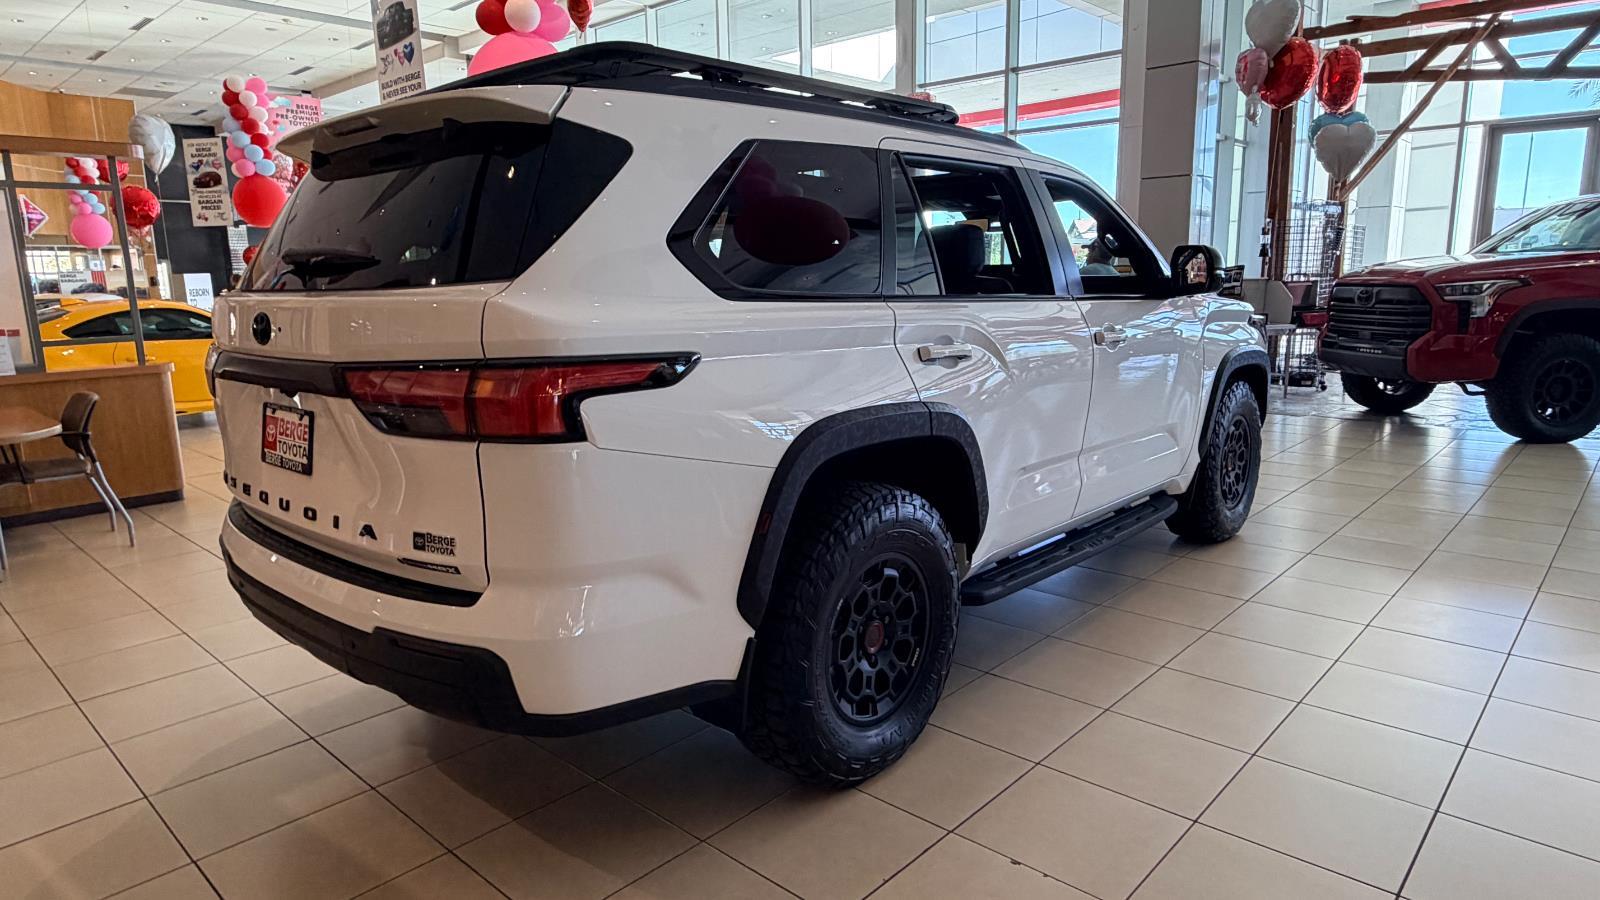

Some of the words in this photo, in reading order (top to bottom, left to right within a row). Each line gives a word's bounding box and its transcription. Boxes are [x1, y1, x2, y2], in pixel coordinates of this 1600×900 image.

[381, 80, 393, 90] BUILD
[393, 76, 404, 86] WITH
[405, 70, 421, 82] BERGE
[386, 88, 399, 98] NEVER
[400, 85, 408, 95] SEE
[408, 81, 422, 92] YOUR
[276, 113, 320, 123] PRE-OWNED
[286, 108, 319, 116] PREMIUM
[188, 288, 210, 298] REBORN
[278, 418, 308, 442] BERGE
[278, 440, 308, 460] TOYOTA
[265, 453, 282, 467] BERGE
[282, 458, 303, 473] TOYOTA
[230, 476, 378, 541] SEQUOIA
[426, 532, 456, 548] BERGE
[425, 544, 456, 557] TOYOTA
